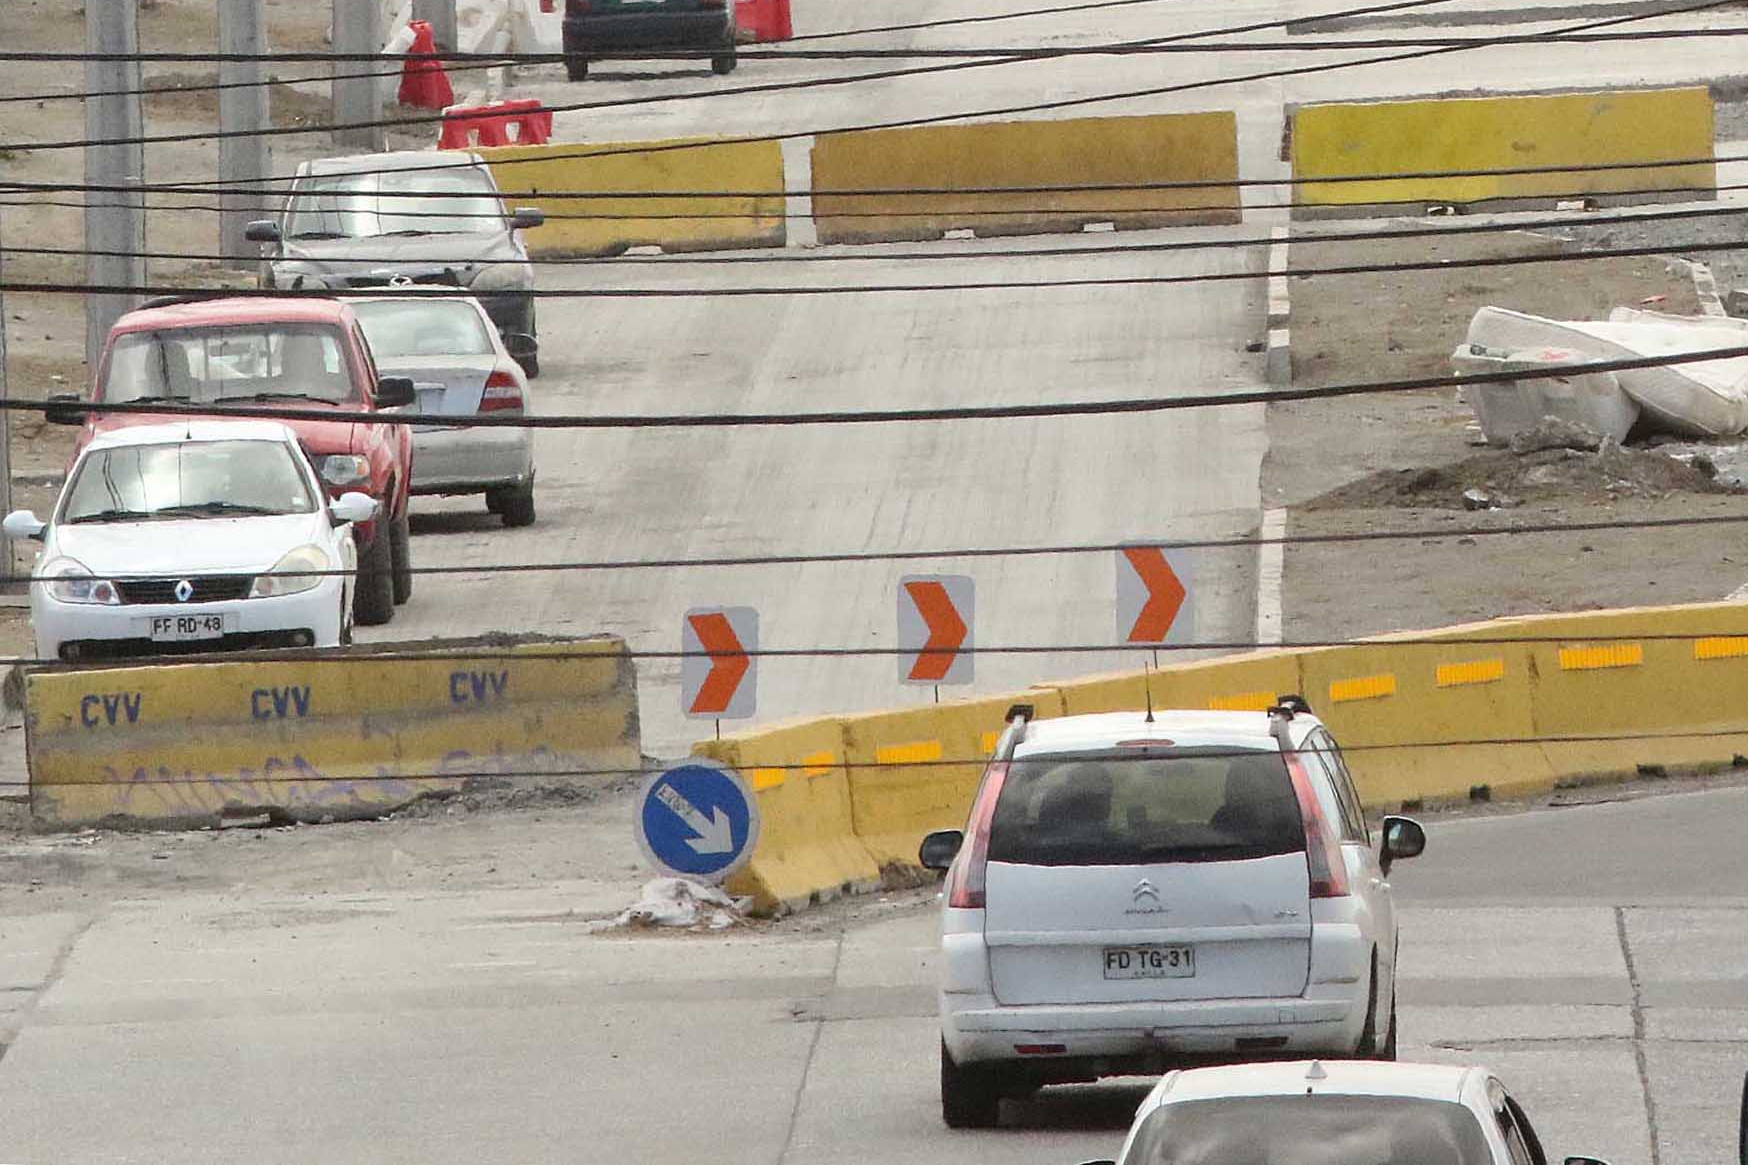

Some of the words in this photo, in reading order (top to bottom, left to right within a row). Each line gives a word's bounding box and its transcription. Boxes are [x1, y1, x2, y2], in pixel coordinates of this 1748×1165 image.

[153, 618, 172, 634] FF
[252, 686, 311, 719] CVV
[450, 669, 508, 703] CVV
[80, 692, 141, 727] CVV
[1107, 950, 1130, 969] FD
